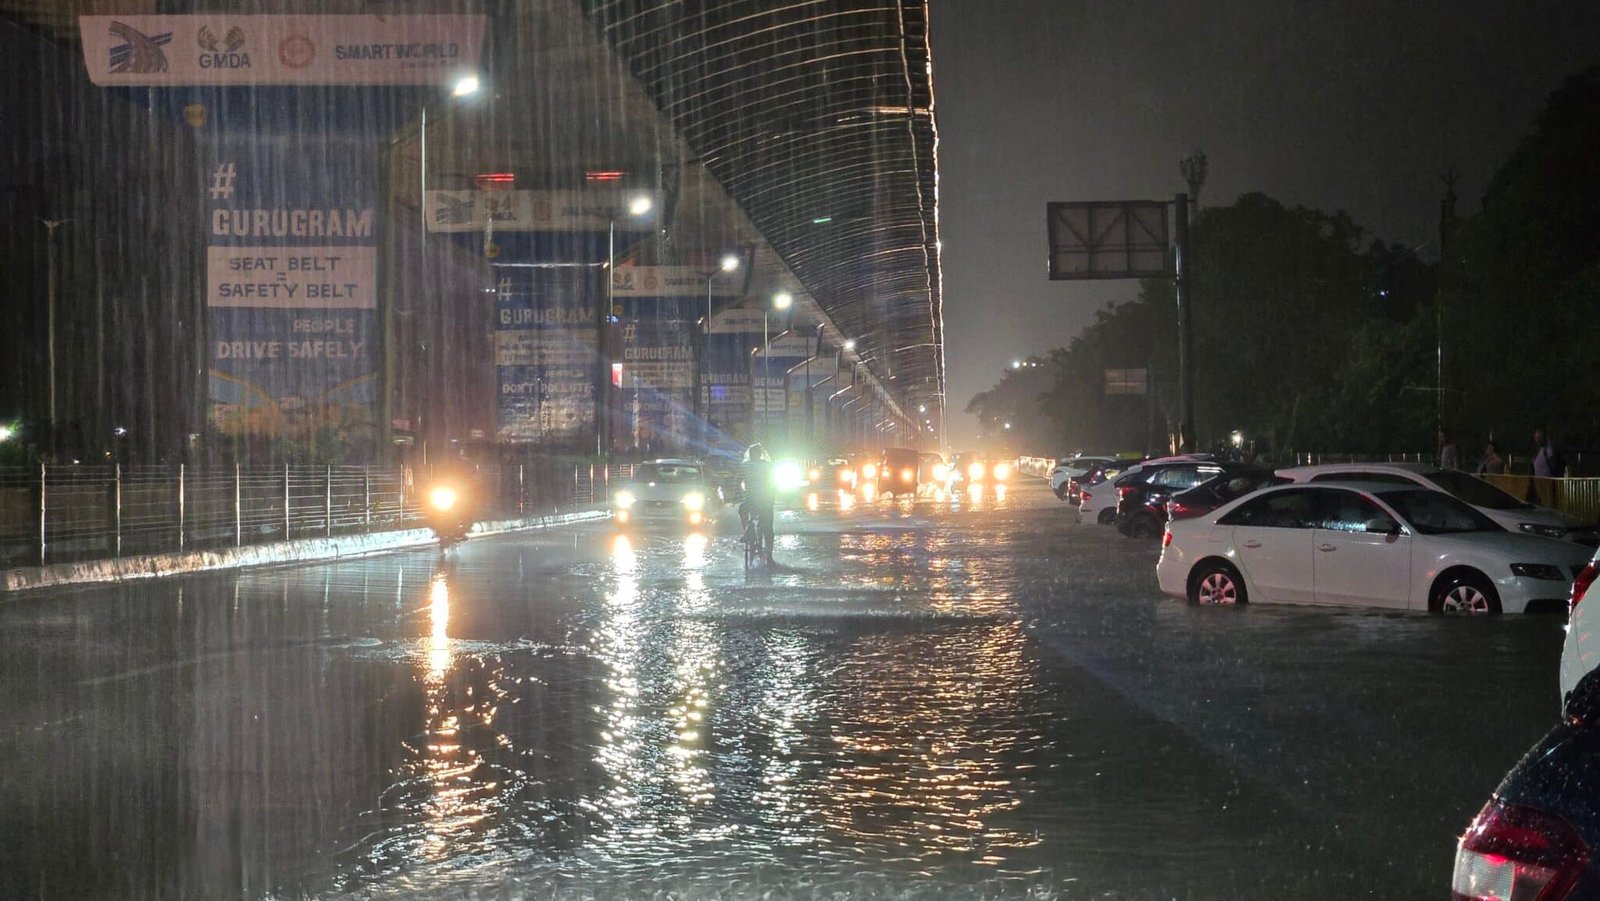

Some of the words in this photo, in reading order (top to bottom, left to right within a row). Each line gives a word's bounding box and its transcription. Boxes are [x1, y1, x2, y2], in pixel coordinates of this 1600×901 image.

[199, 53, 251, 69] GMDA
[209, 163, 236, 199] #
[212, 208, 373, 237] GURUGRAM
[229, 257, 278, 271] SEAT
[288, 257, 341, 271] BELT
[218, 284, 299, 298] SAFETY
[306, 284, 358, 298] BELT
[500, 307, 597, 325] GURUGRAM
[293, 318, 356, 334] PEOPLE
[217, 341, 281, 359] DRIVE
[288, 341, 364, 359] SAFELY
